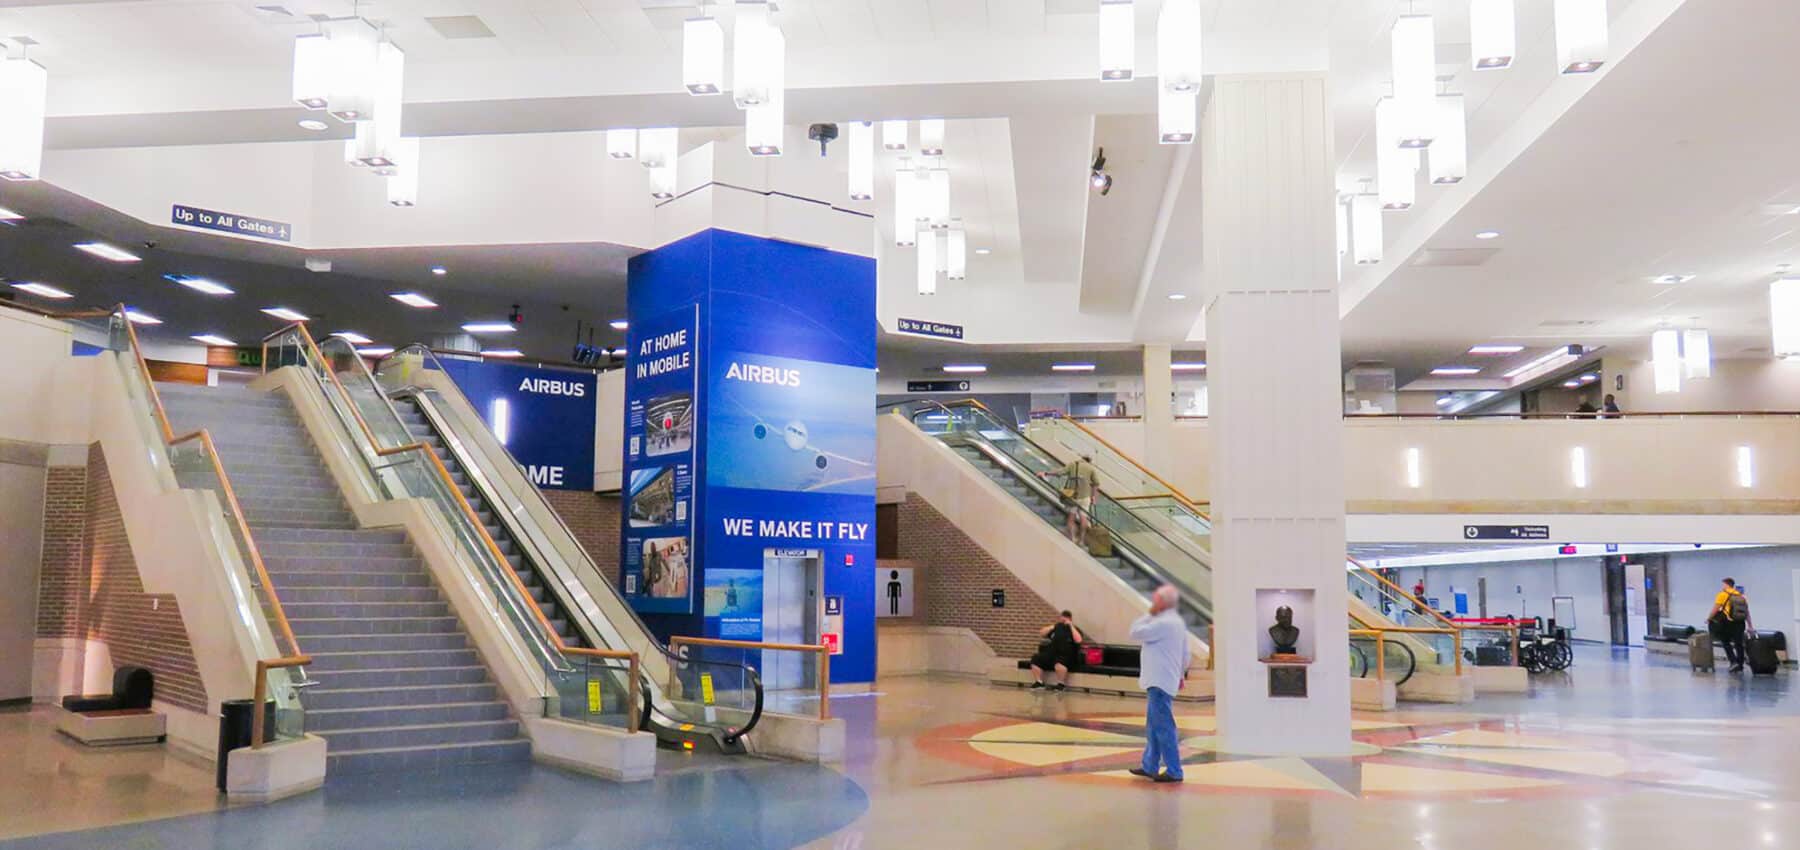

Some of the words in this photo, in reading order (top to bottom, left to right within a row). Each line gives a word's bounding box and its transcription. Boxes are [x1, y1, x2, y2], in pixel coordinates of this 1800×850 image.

[175, 208, 194, 223] Up
[200, 213, 212, 224] to
[217, 216, 233, 227] All
[238, 219, 274, 234] Gates
[899, 320, 910, 330] Up
[912, 322, 920, 330] to
[921, 324, 931, 332] All
[933, 324, 954, 335] Gates
[640, 339, 653, 356] AT
[655, 329, 687, 352] HOME
[637, 362, 647, 379] IN
[650, 351, 690, 376] MOBILE
[726, 362, 801, 387] AIRBUS
[519, 377, 585, 397] AIRBUS
[723, 518, 753, 537] WE
[759, 520, 812, 539] MAKE
[818, 522, 834, 540] IT
[839, 523, 869, 541] FLY
